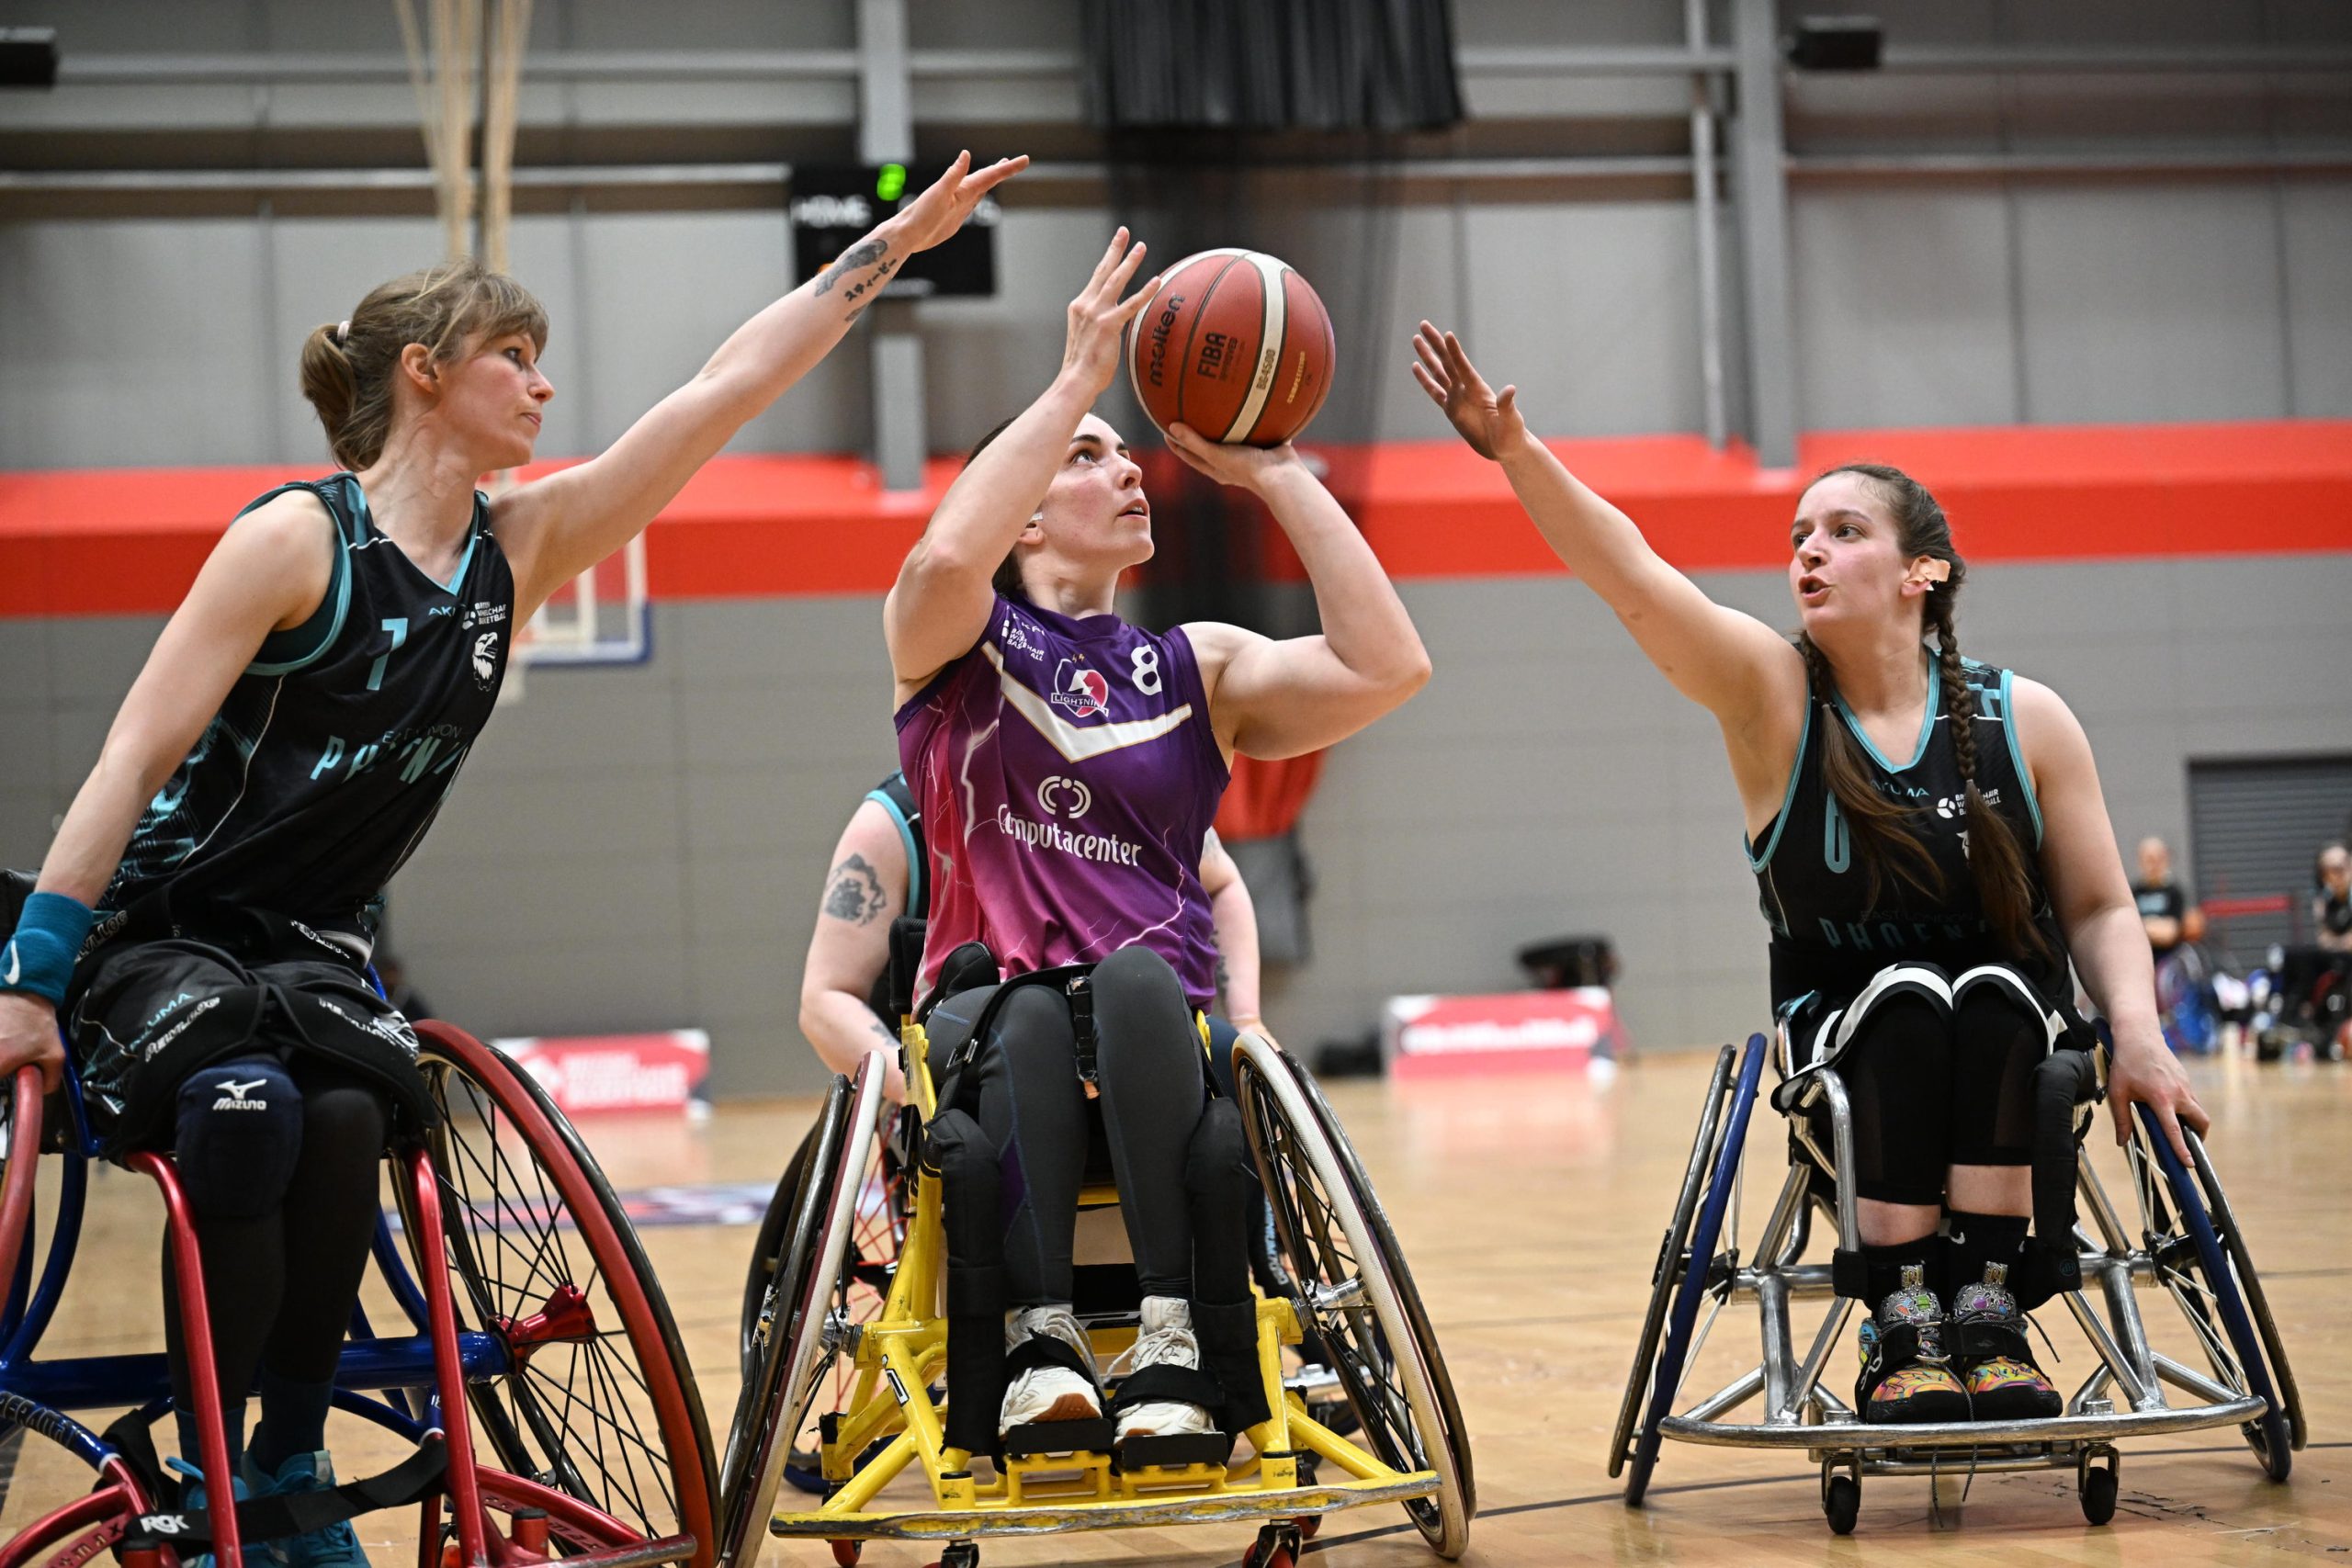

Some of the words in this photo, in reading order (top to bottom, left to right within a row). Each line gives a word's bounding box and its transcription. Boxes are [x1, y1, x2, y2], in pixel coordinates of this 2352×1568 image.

[1149, 293, 1185, 387] molten
[1197, 332, 1227, 379] FIBA
[367, 617, 408, 691] 7
[1130, 645, 1162, 695] 8
[1054, 694, 1100, 708] LIGHTNI
[1818, 917, 1985, 951] PHOEN
